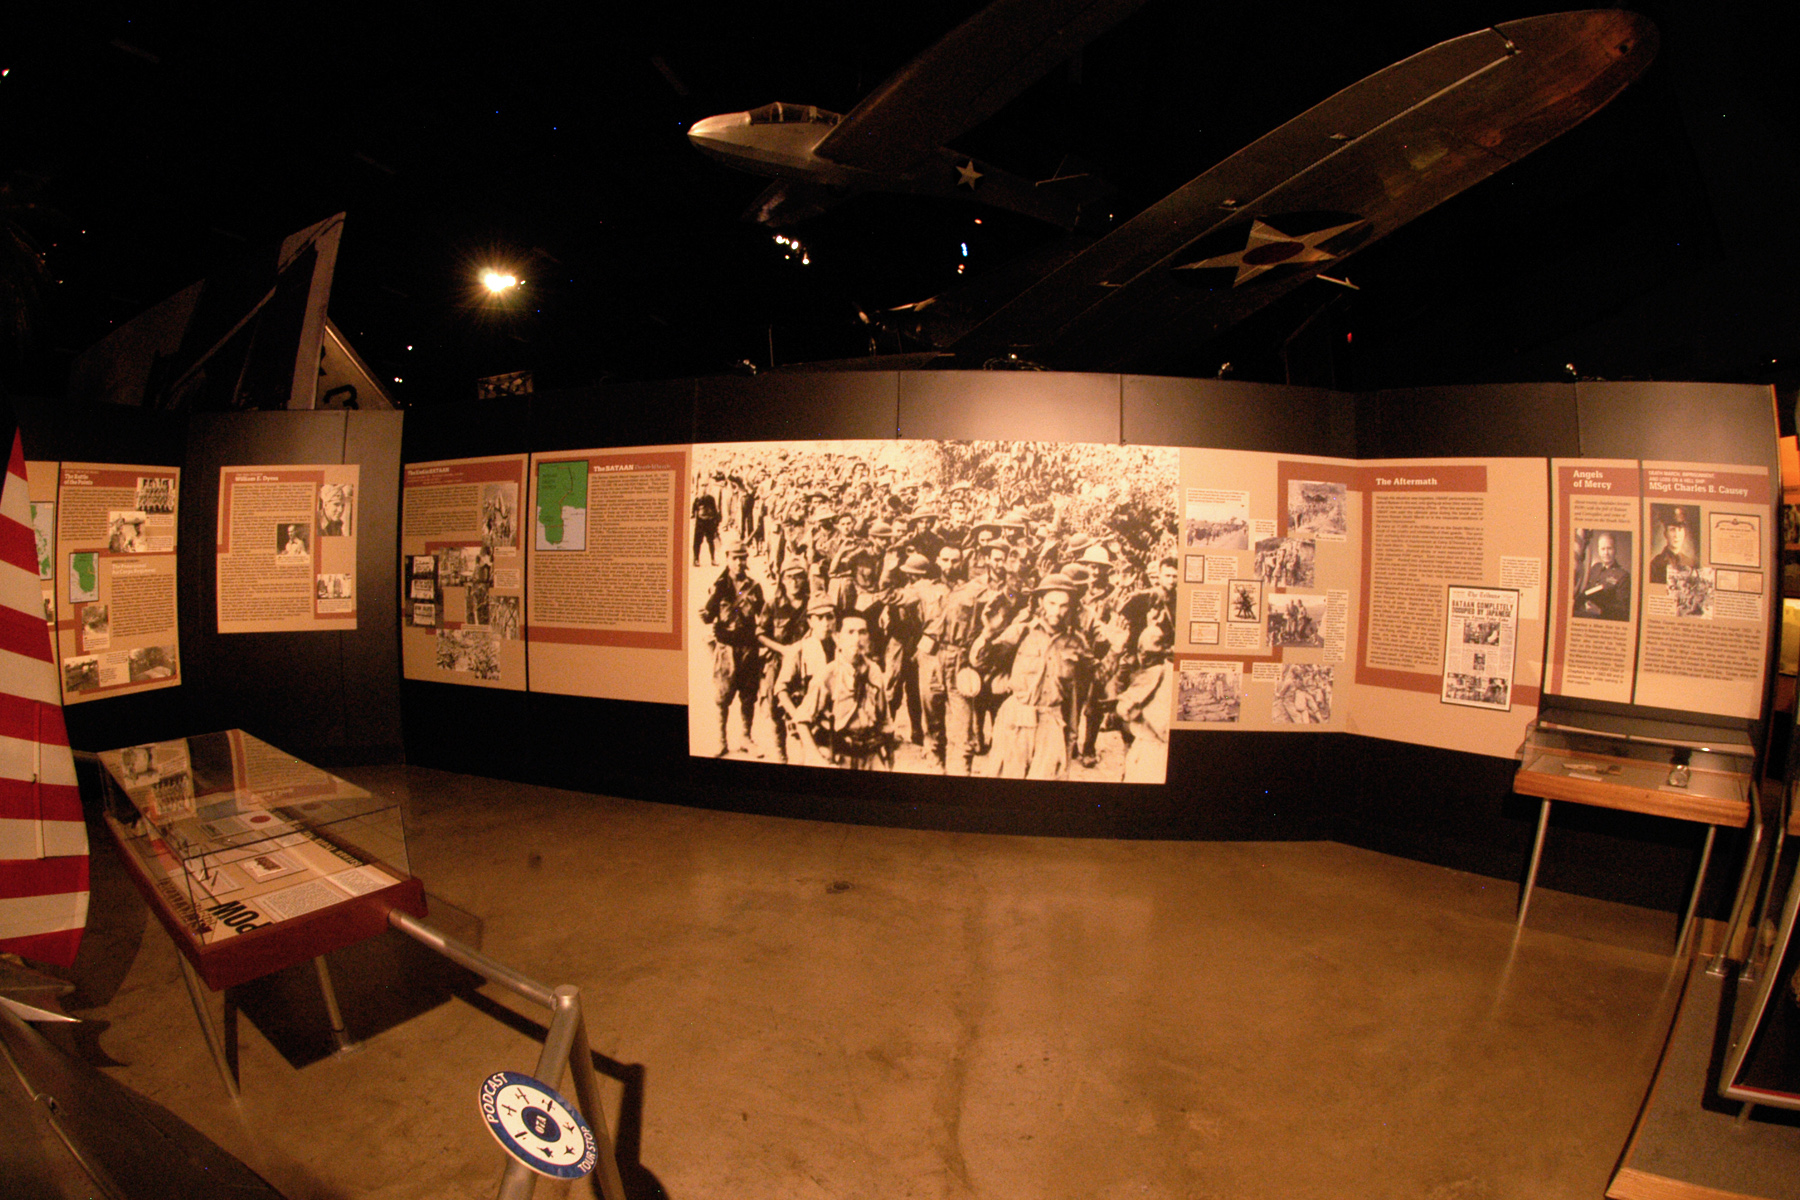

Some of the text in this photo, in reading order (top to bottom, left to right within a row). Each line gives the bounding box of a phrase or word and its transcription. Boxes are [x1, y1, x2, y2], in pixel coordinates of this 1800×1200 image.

[1573, 470, 1603, 479] Angels
[1376, 477, 1437, 486] The Aftermath
[1584, 480, 1612, 490] Mercy
[1649, 482, 1749, 497] MSgt Charles B. Causey
[1477, 602, 1513, 611] COMPLETELY
[206, 900, 275, 934] POW
[482, 1072, 508, 1124] PODCAST
[577, 1125, 596, 1173] TOUR STOP
